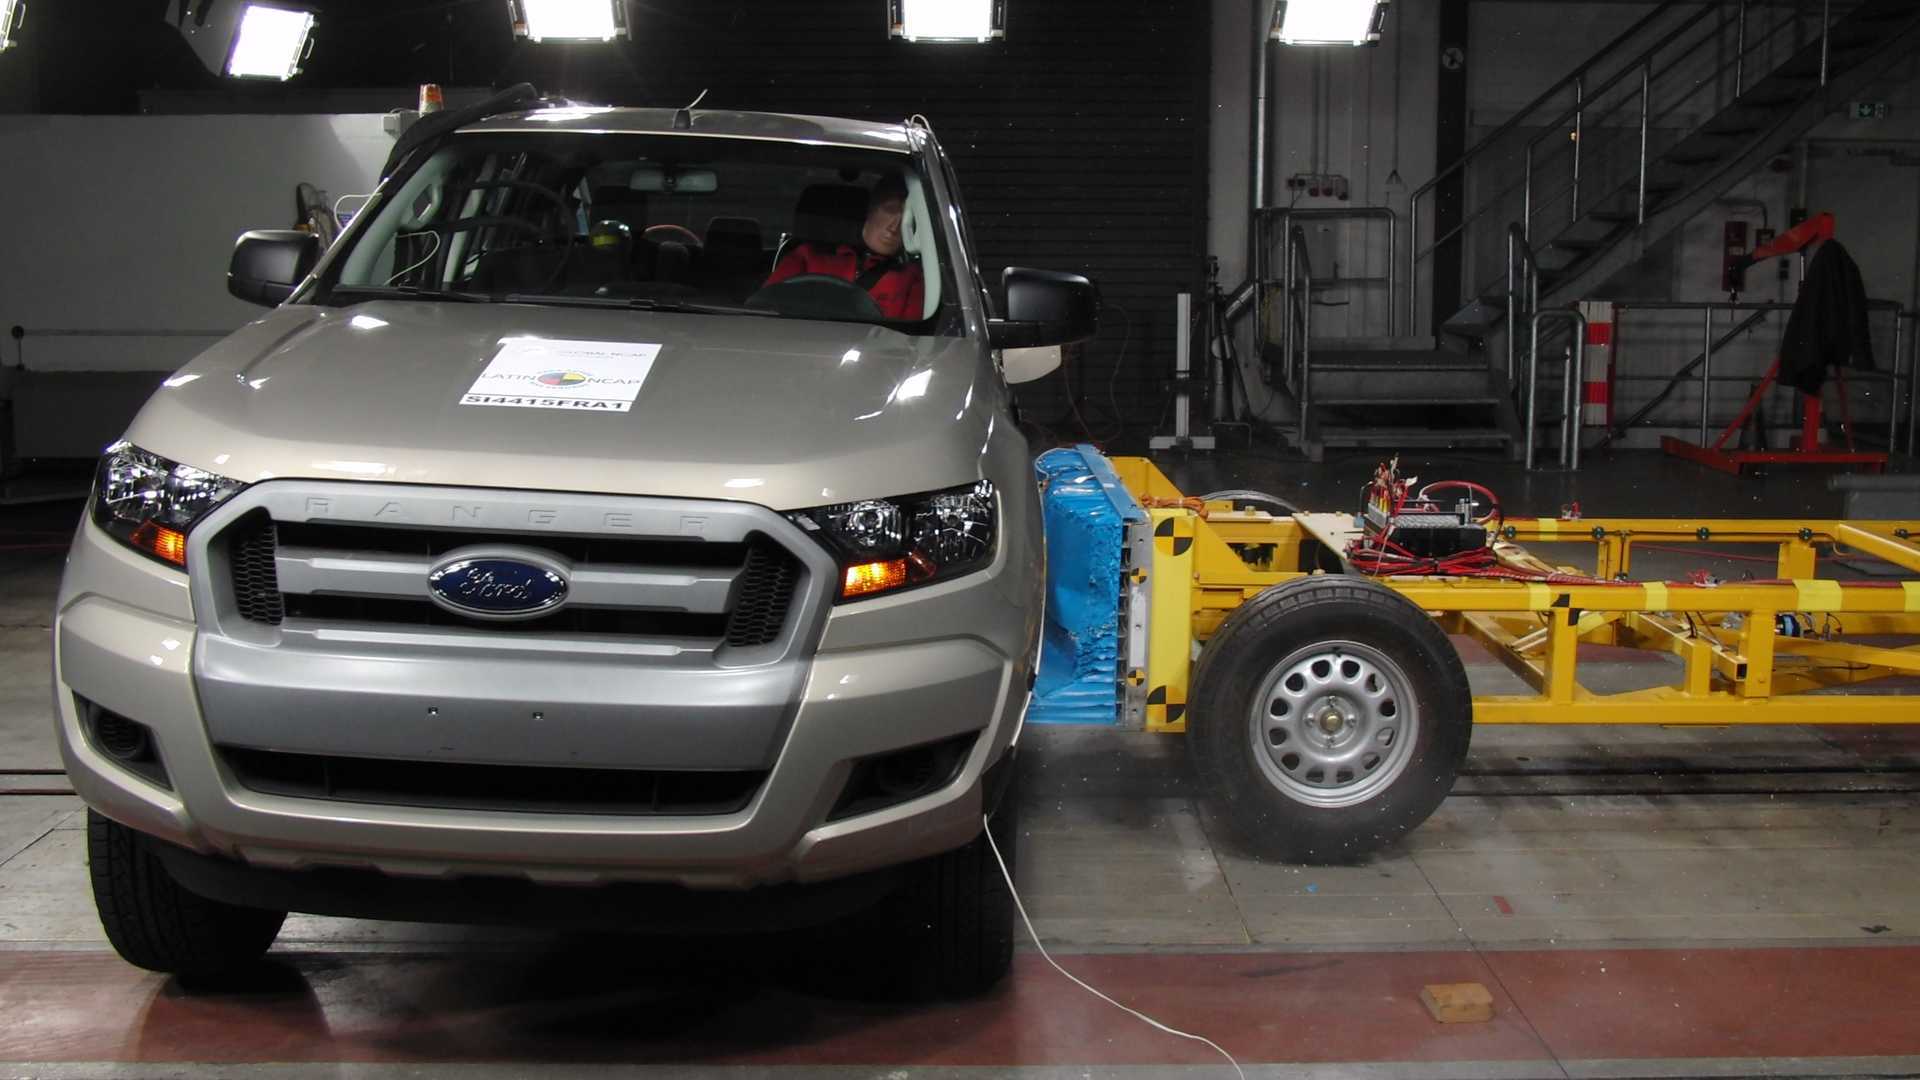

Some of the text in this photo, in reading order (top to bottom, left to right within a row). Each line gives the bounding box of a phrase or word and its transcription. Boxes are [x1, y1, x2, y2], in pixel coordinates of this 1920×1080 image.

[481, 373, 641, 385] LATIN NCAP
[466, 395, 623, 410] SI4415FRA1
[304, 495, 711, 532] RANGER
[459, 567, 531, 602] Ford
